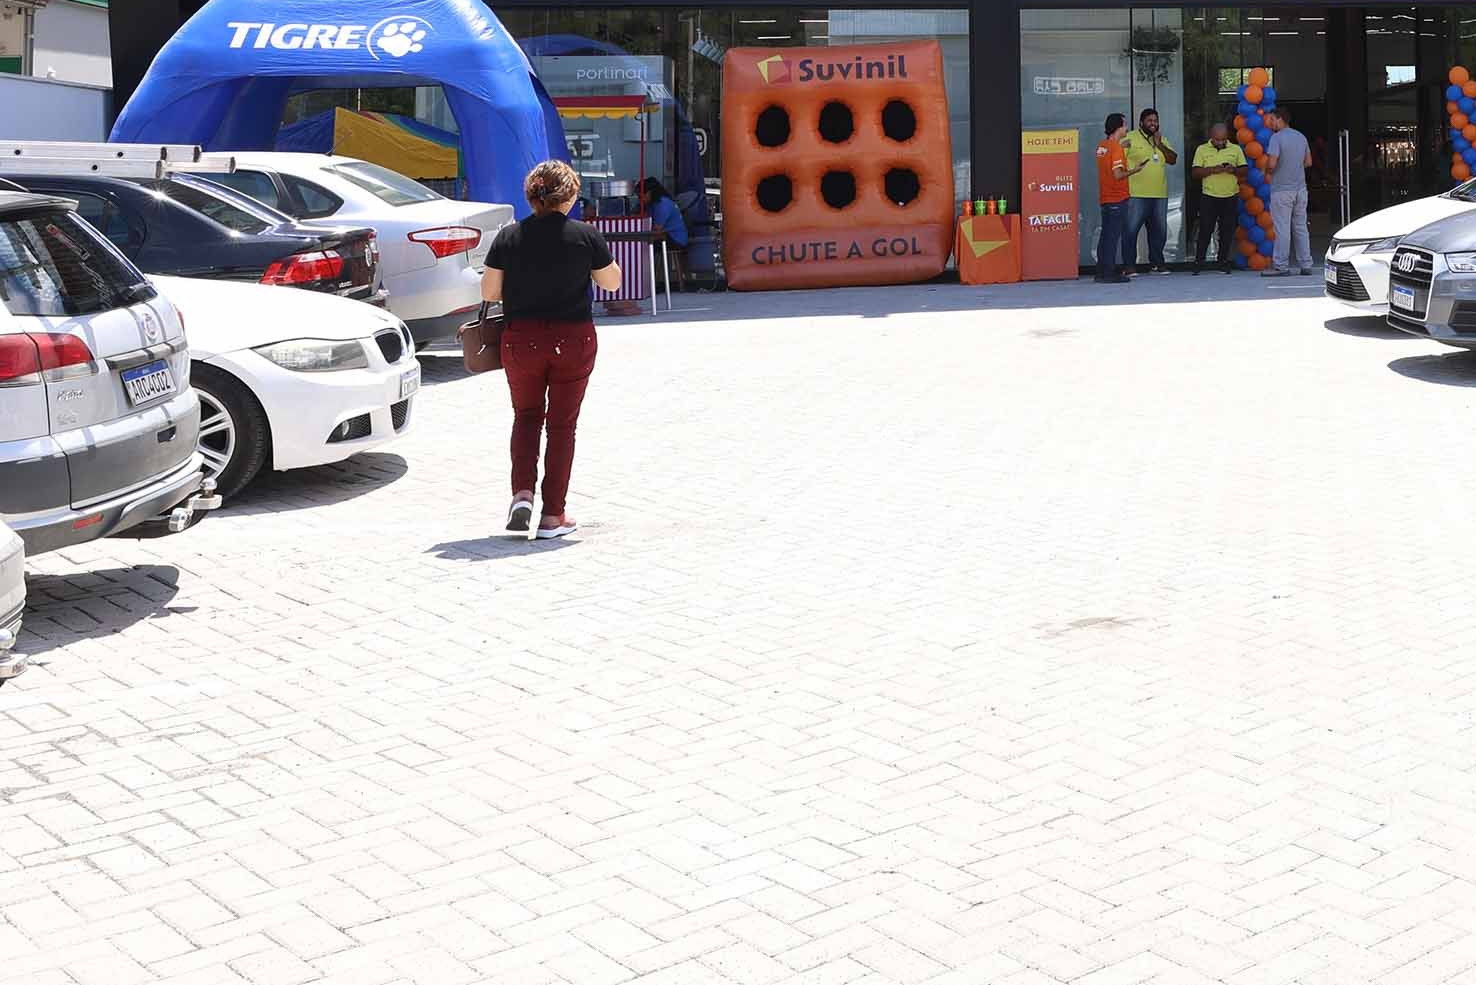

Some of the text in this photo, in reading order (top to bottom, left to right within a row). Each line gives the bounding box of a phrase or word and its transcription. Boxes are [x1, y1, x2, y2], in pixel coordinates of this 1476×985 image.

[227, 22, 368, 50] TIGRE
[799, 55, 908, 81] Suvinil
[1039, 182, 1073, 192] Suvinil
[751, 236, 922, 265] CHUTE A GOL
